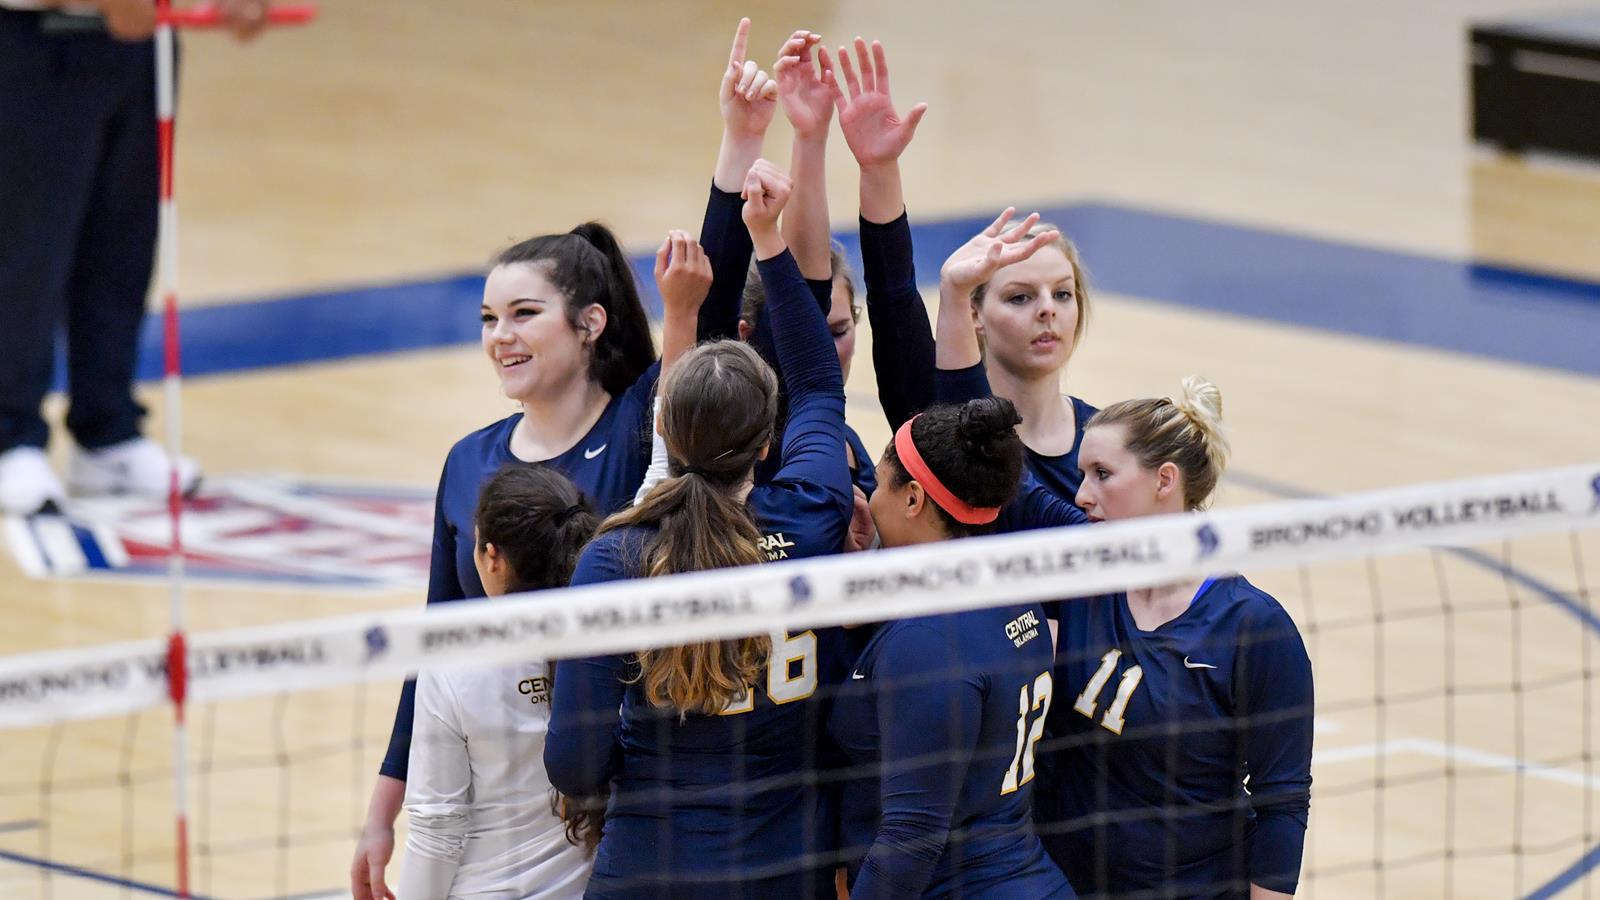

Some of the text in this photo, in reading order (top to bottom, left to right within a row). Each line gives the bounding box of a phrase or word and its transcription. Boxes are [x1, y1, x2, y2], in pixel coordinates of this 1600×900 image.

[1249, 489, 1563, 549] BRONCHO VOLLEYBALL
[991, 537, 1164, 579] VOLLEYBALL
[576, 590, 756, 631] VOLLEYBALL
[1005, 610, 1040, 640] CENTRAL
[1014, 628, 1039, 648] OKLAHOMA
[1074, 648, 1142, 736] 11
[999, 671, 1053, 796] 12
